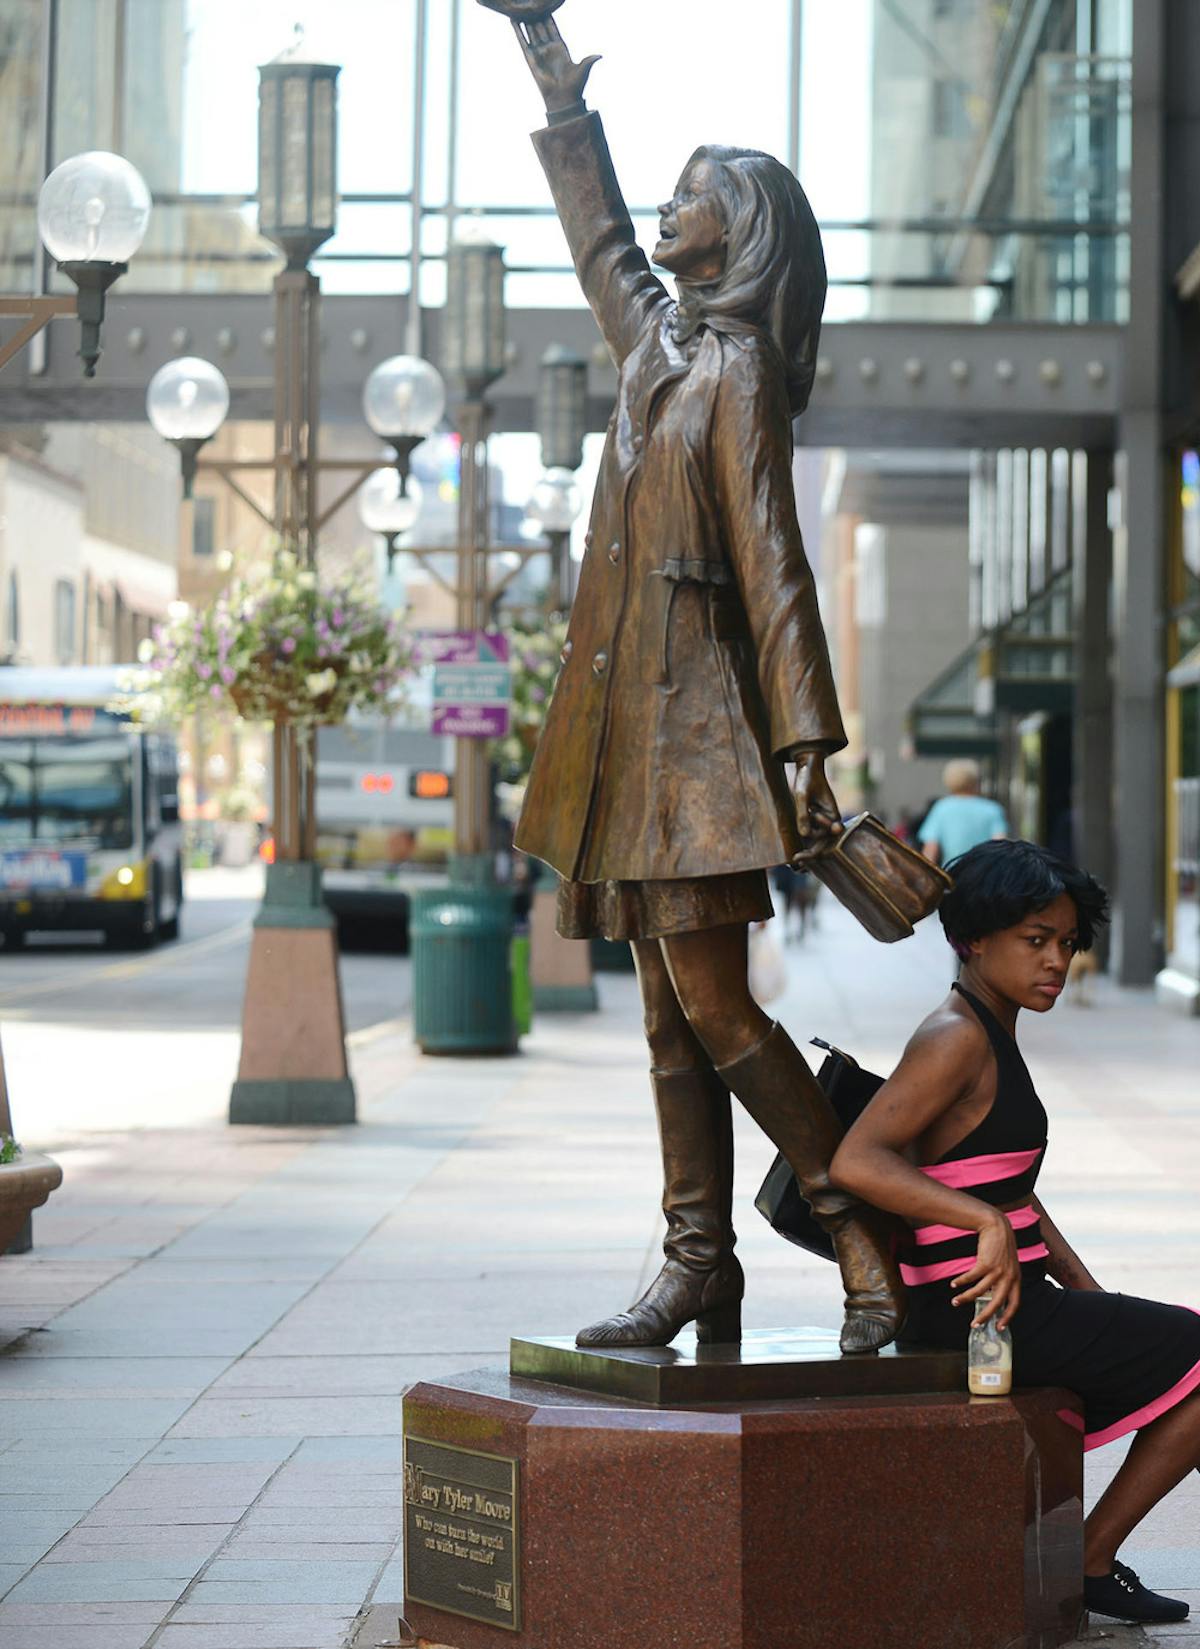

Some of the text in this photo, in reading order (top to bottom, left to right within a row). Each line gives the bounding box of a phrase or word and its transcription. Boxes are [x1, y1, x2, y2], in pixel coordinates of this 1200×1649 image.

[405, 1462, 511, 1519] Mary Tyler Moore
[415, 1514, 504, 1550] Who can turn the world
[424, 1537, 435, 1550] on
[436, 1540, 454, 1554] with
[454, 1542, 468, 1558] her
